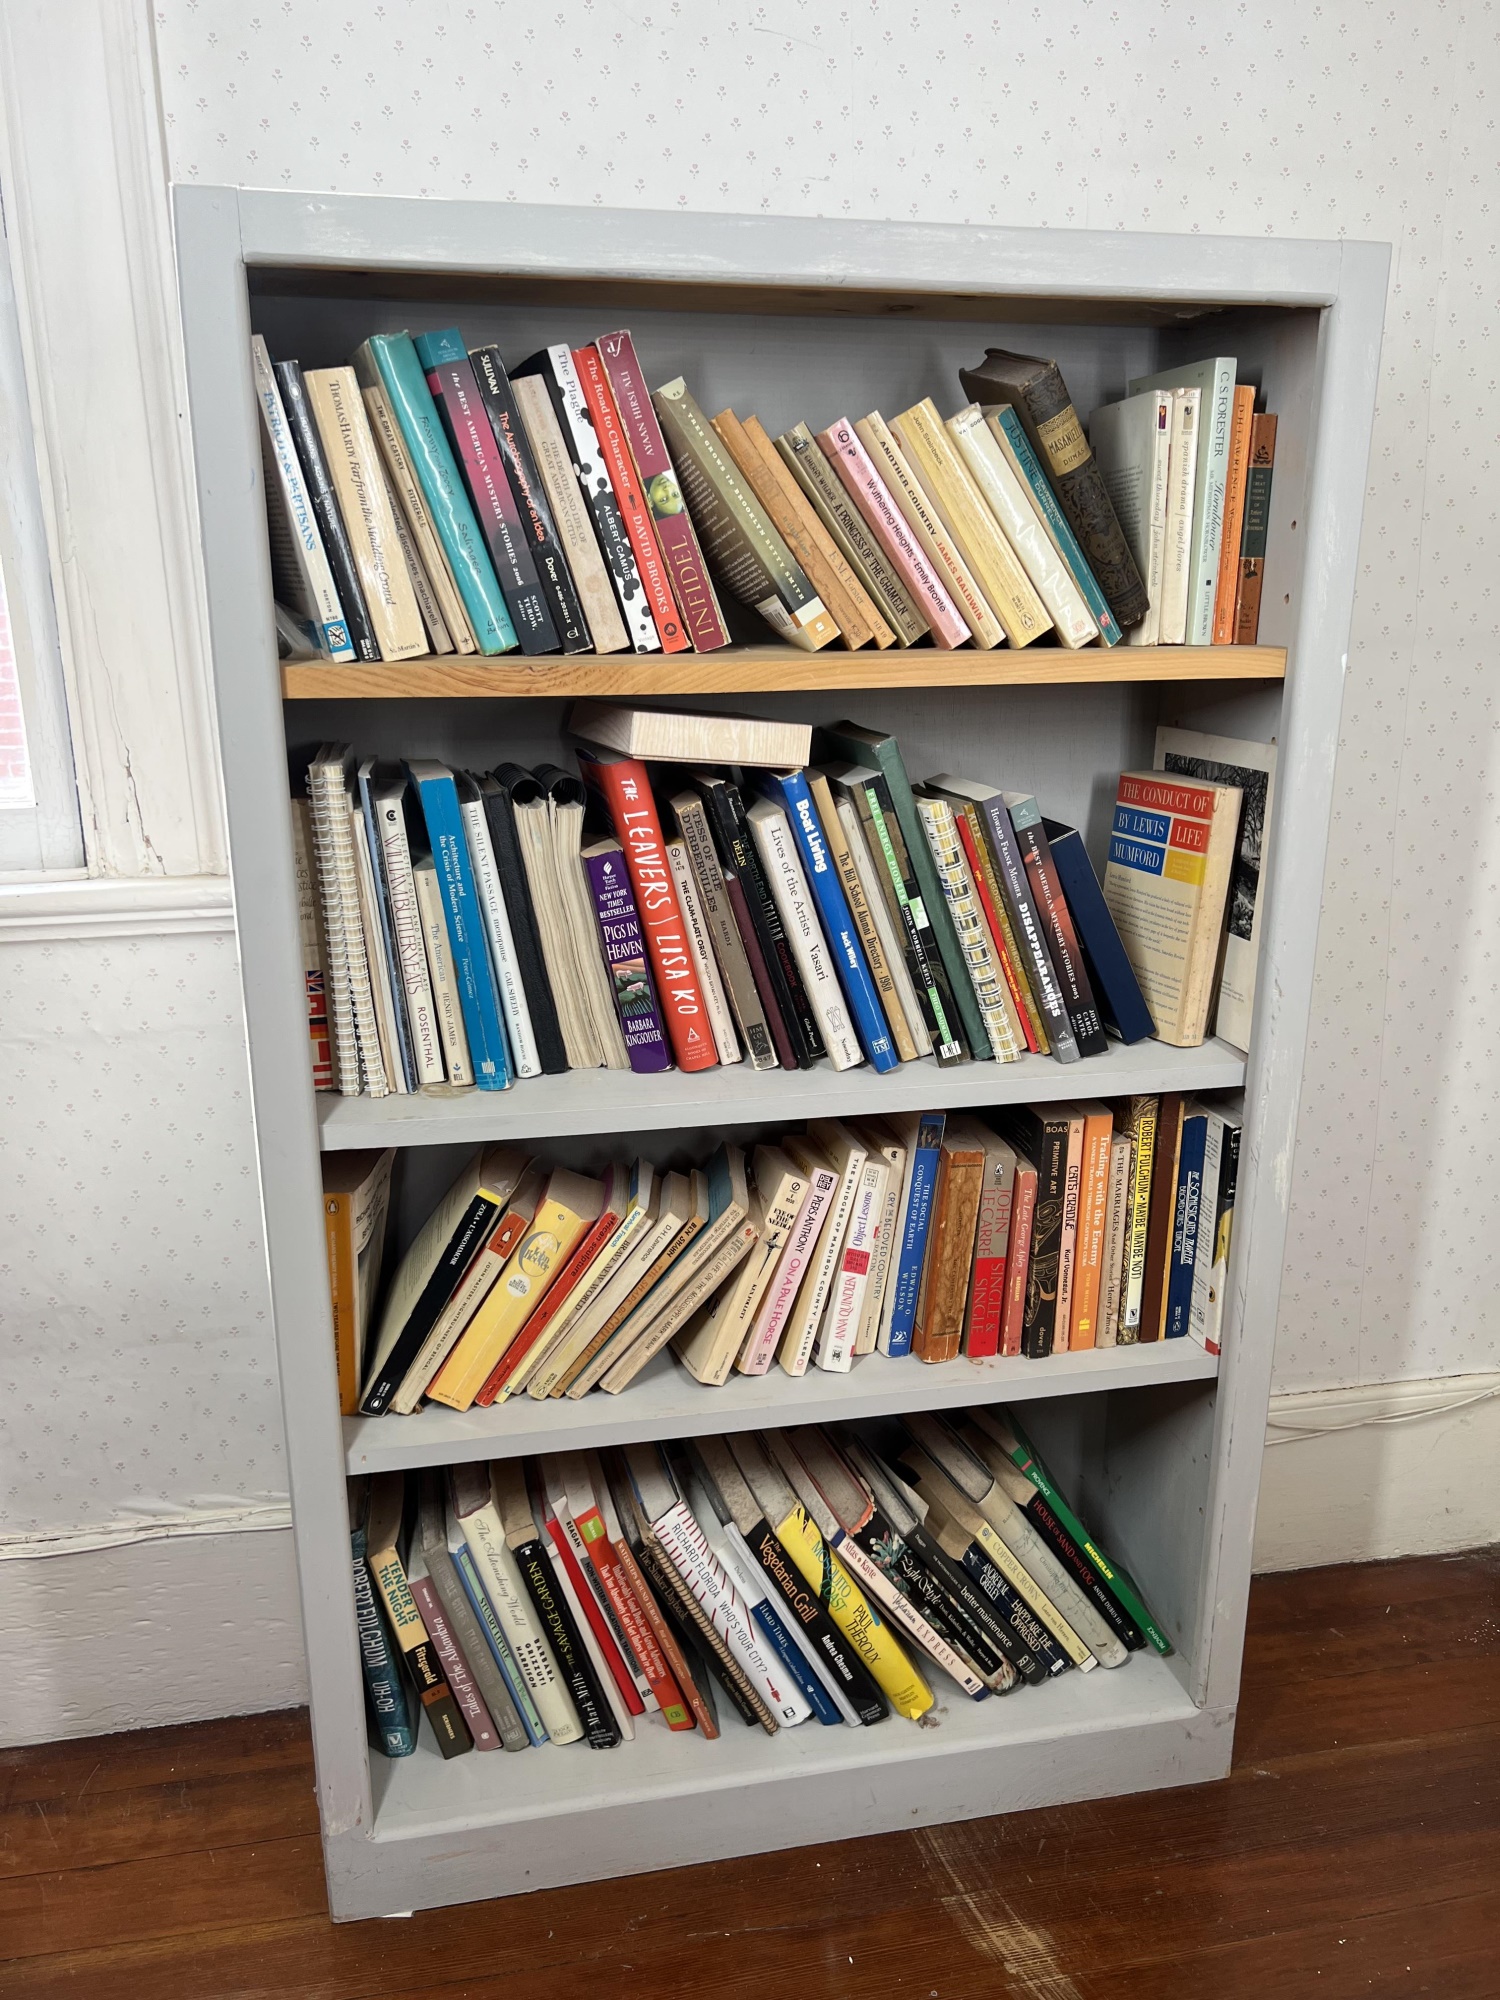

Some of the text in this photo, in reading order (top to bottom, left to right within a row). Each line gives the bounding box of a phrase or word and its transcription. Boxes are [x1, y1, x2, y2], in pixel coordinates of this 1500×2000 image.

[558, 352, 584, 423] The Plague
[620, 370, 654, 456] AYAAN HIRSI ALI
[913, 416, 944, 466] John Steinbeck
[1215, 397, 1228, 457] FORESTER
[480, 354, 558, 581] SULLIVAN The Autobiography Idea Dover
[1063, 448, 1084, 466] DUMAS
[458, 389, 524, 585] BEST AMERICAN MYSTERY STORIES 2006
[587, 357, 669, 614] The Road Character DAVID BROOKS
[688, 413, 703, 436] TREE
[704, 440, 724, 472] GROWS
[735, 488, 765, 539] BROOKLYN
[765, 539, 784, 567] BETTY
[785, 572, 805, 600] SMITH
[604, 505, 632, 581] ALBERT CAMUS
[867, 479, 931, 588] Wuthering Heights Emily
[880, 441, 984, 621] ANOTHER COUNTRY JAMES BALDWIN
[417, 581, 439, 626] machiavelli
[530, 595, 544, 623] SCOTT
[672, 535, 714, 636] INFIDEL
[1123, 782, 1190, 809] THE CONDUCT
[1134, 816, 1164, 837] LEWIS
[1176, 826, 1202, 846] LIFE
[449, 835, 461, 881] Architecture
[621, 778, 686, 980] THE LEAVERS LISA
[796, 798, 858, 968] Boat Living Jack Wiley
[1113, 843, 1159, 868] MUMFORD
[442, 850, 463, 942] Crisis Modern Science
[600, 888, 627, 901] NEW YORK
[600, 905, 635, 918] BESTSELLER
[607, 898, 624, 909] TIMES
[771, 828, 828, 981] Lives the Artists Vasari
[991, 808, 1061, 1018] HOWARD FRANK MOSHER DISAPPEARANCES
[604, 925, 622, 942] PIGS
[606, 940, 644, 961] HEAVEN
[686, 896, 709, 961] CLAM-PLATE ORGY
[418, 1007, 434, 1068] ROSENTHAL
[626, 1031, 662, 1047] KINGSOLVER
[627, 1018, 654, 1031] BARBARA
[1051, 1141, 1060, 1177] PRIMITIVE
[1135, 1120, 1152, 1228] ROBERT FULGHUM MAYBE
[852, 1219, 864, 1246] Object
[858, 1191, 872, 1219] Lessons
[906, 1165, 924, 1250] CONQUEST EARTH
[918, 1202, 927, 1232] SOCIAL
[994, 1188, 1011, 1233] JOHN
[1088, 1134, 1109, 1266] Trading with the Enemy
[571, 1216, 617, 1277] african sculpture
[611, 1210, 640, 1248] Survival French
[667, 1222, 697, 1258] BEN SHAHN
[762, 1195, 824, 1345] PIERS ANTHONY PALE HORSE
[801, 1159, 860, 1356] THE BRIDGES MADISON COUNTY WALLER
[908, 1265, 917, 1304] EDWARD
[834, 1316, 846, 1340] ANNA
[840, 1276, 856, 1317] QUINDLEN
[898, 1272, 908, 1310] WILSON
[972, 1278, 988, 1333] SINGLE
[986, 1263, 1004, 1316] SINGLE
[565, 1520, 582, 1548] REAGAN
[1031, 1472, 1166, 1649] PROVENCE MICHELIN PROVENCE
[1033, 1500, 1095, 1585] HOUSE SAND FOG
[379, 1566, 408, 1627] THE NIGHT
[389, 1560, 412, 1607] TENDER
[759, 1536, 818, 1623] Vegetarian Grill
[992, 1540, 1039, 1600] COPPER CROWN
[672, 1524, 768, 1672] RICHARD FLORIDA WHO'S YOUR CITY?
[759, 1603, 789, 1648] HARD TIMES
[853, 1605, 874, 1629] PAUL
[960, 1586, 1013, 1648] better maintenance
[357, 1610, 387, 1667] FULGHUM
[415, 1646, 438, 1685] Fitzgerald
[525, 1643, 546, 1686] GRIZZUTI
[527, 1562, 600, 1726] Mark Mills SAVAGE GARDEN
[534, 1638, 555, 1682] BARBARA
[821, 1634, 854, 1680] Andrea Chesman
[846, 1618, 881, 1664] THEROUX
[917, 1624, 955, 1666] EXPRESS
[516, 1646, 537, 1688] HARRISON
